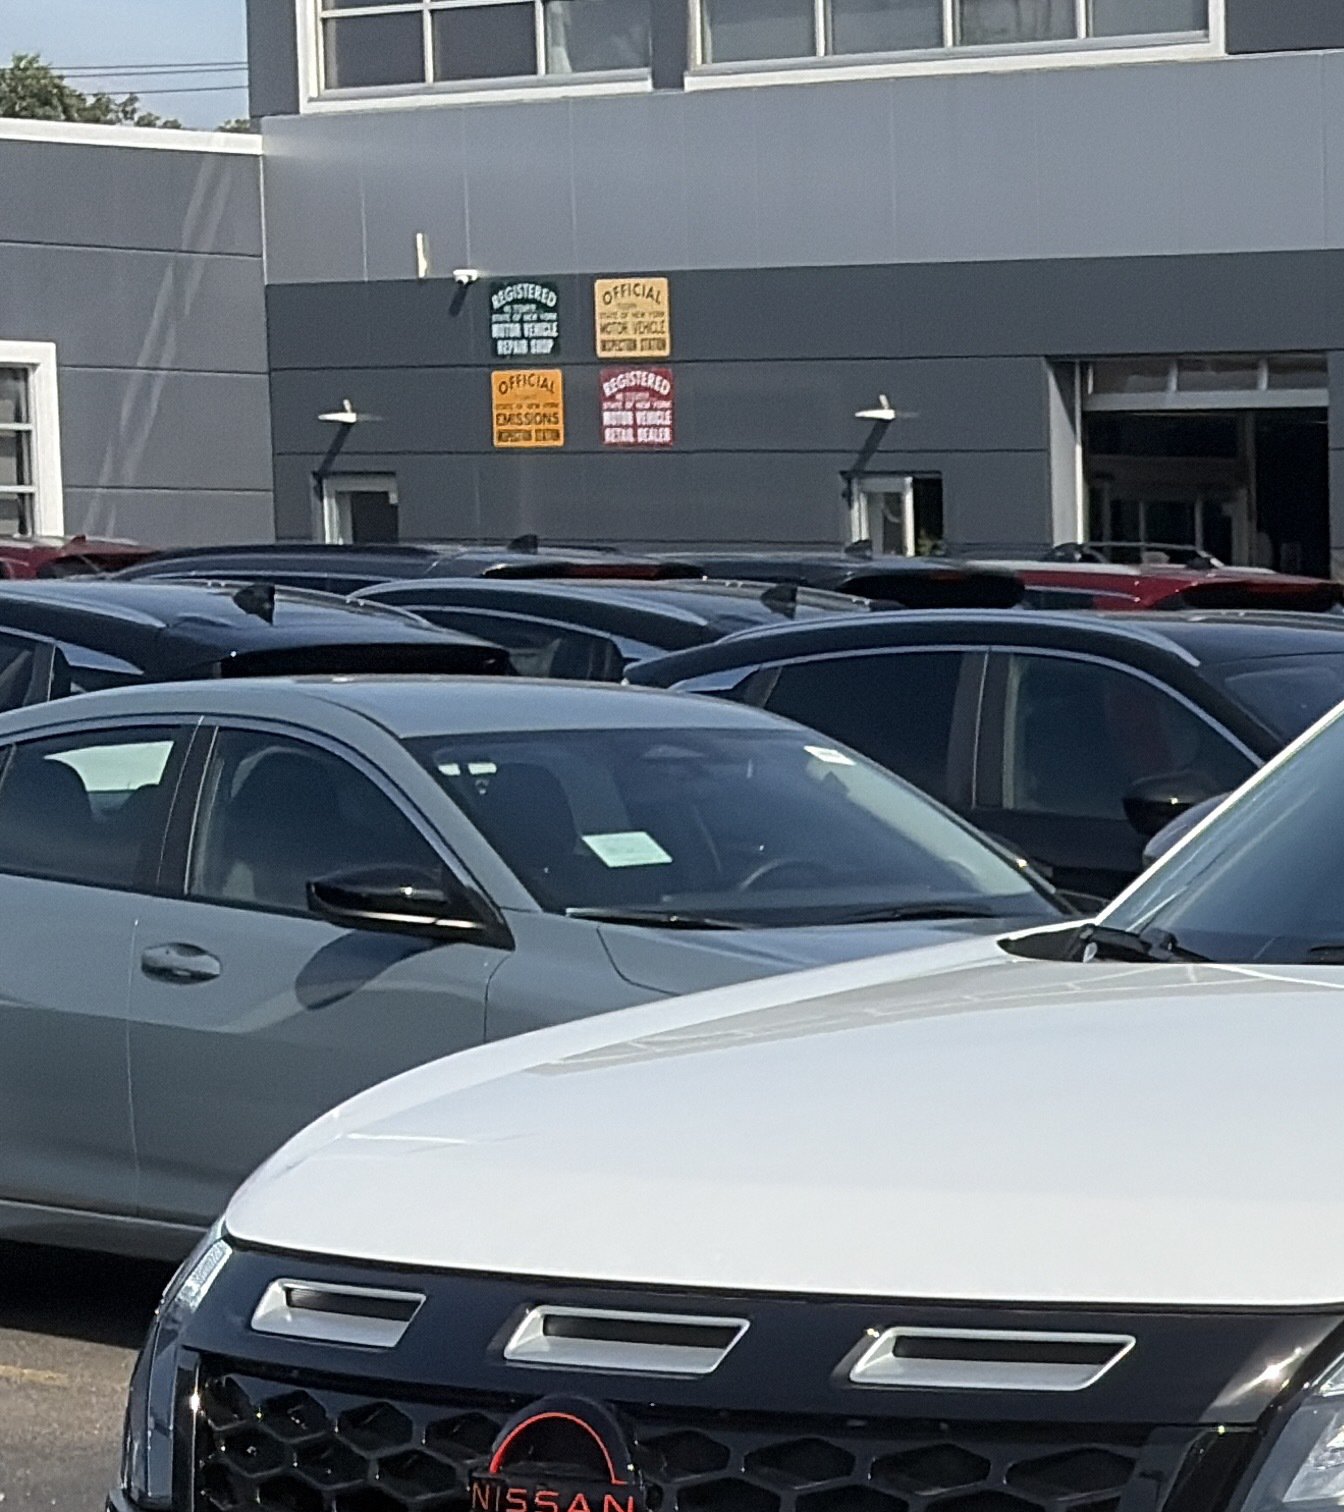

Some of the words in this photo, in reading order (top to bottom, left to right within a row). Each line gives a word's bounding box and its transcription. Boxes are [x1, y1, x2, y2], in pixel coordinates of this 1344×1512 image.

[492, 283, 557, 309] REGISTERED
[603, 283, 661, 305] OFFICIAL
[492, 323, 521, 338] MOTOR
[523, 322, 558, 338] VEHICLE
[600, 322, 627, 335] MOTOR
[633, 321, 666, 335] VEHICLE
[497, 339, 528, 355] REPAIR
[531, 339, 554, 354] SHOP
[499, 373, 555, 394] OFFICIAL
[603, 370, 670, 397] REGISTERED
[496, 412, 559, 427] EMISSIONS
[602, 411, 634, 426] MOTOR
[636, 410, 672, 426] VEHICLE
